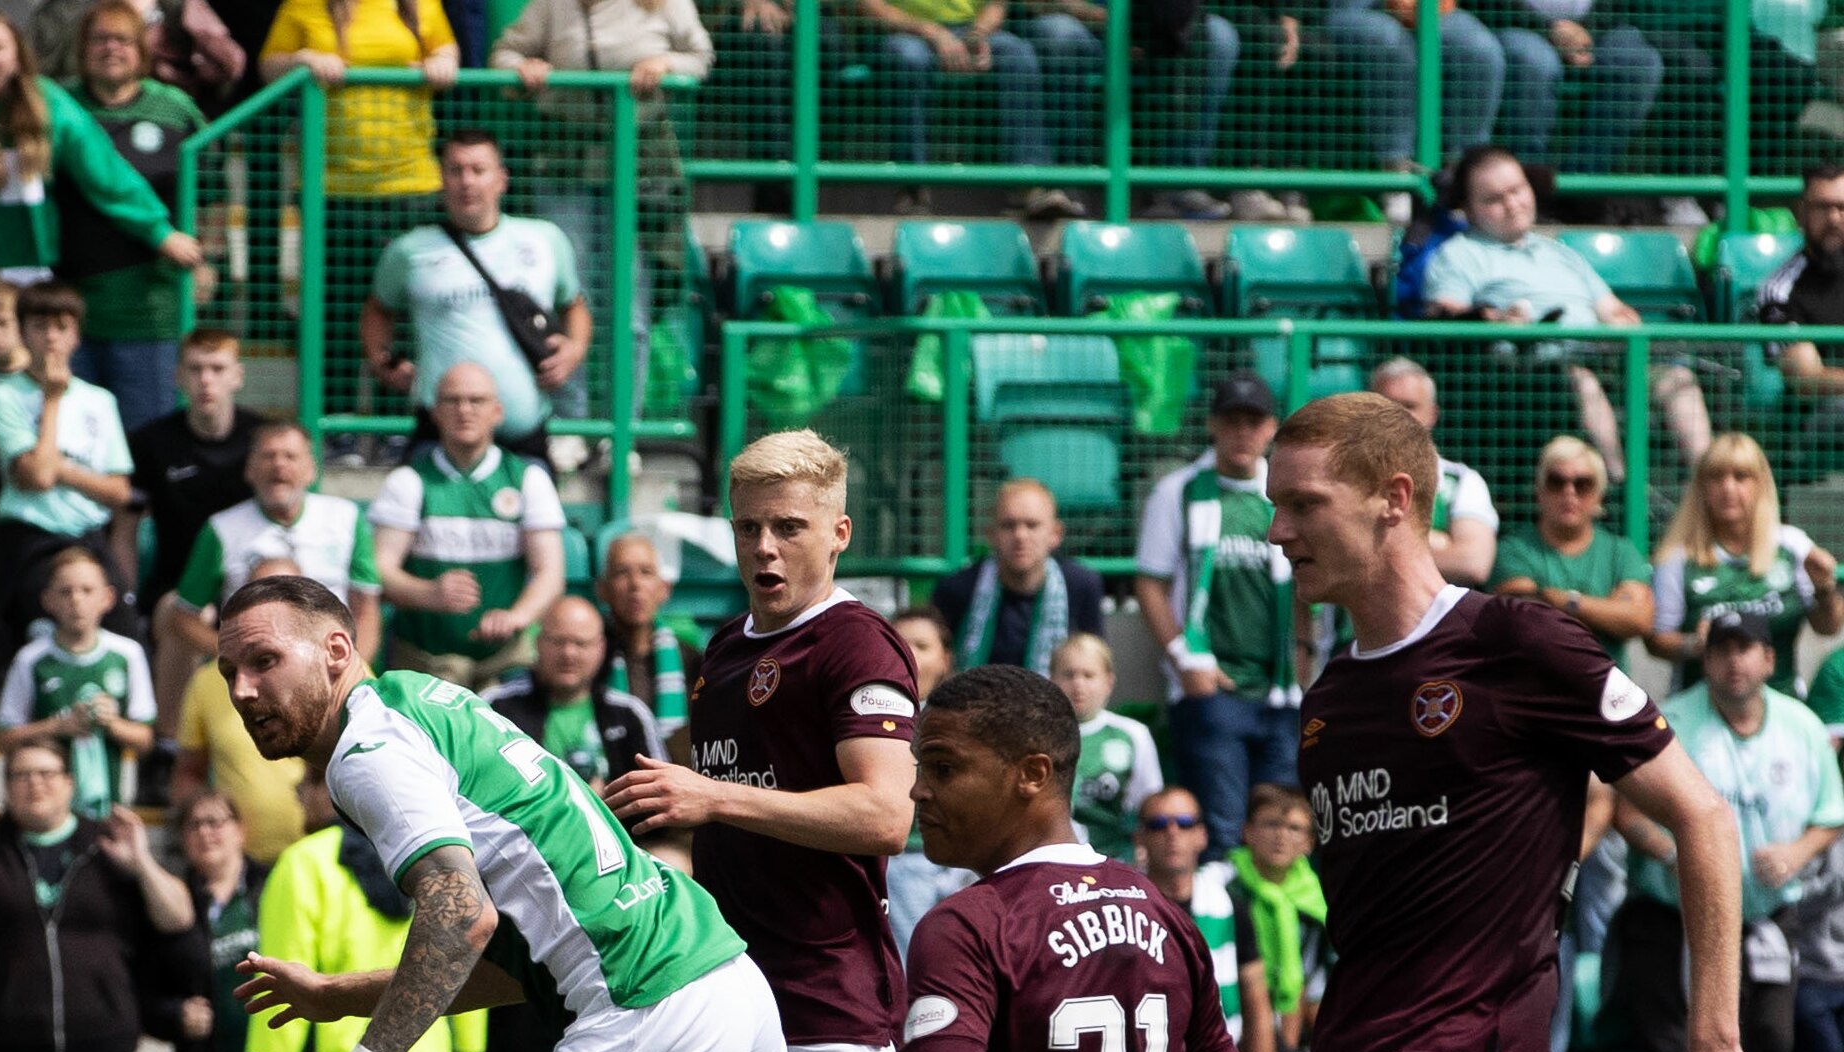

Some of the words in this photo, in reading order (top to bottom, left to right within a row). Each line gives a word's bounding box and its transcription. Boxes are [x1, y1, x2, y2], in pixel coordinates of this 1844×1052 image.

[702, 738, 738, 767] MND
[499, 738, 625, 876] 7
[1336, 768, 1391, 805] MND
[1339, 795, 1448, 837] Scotland
[1048, 904, 1168, 968] SIBBICK
